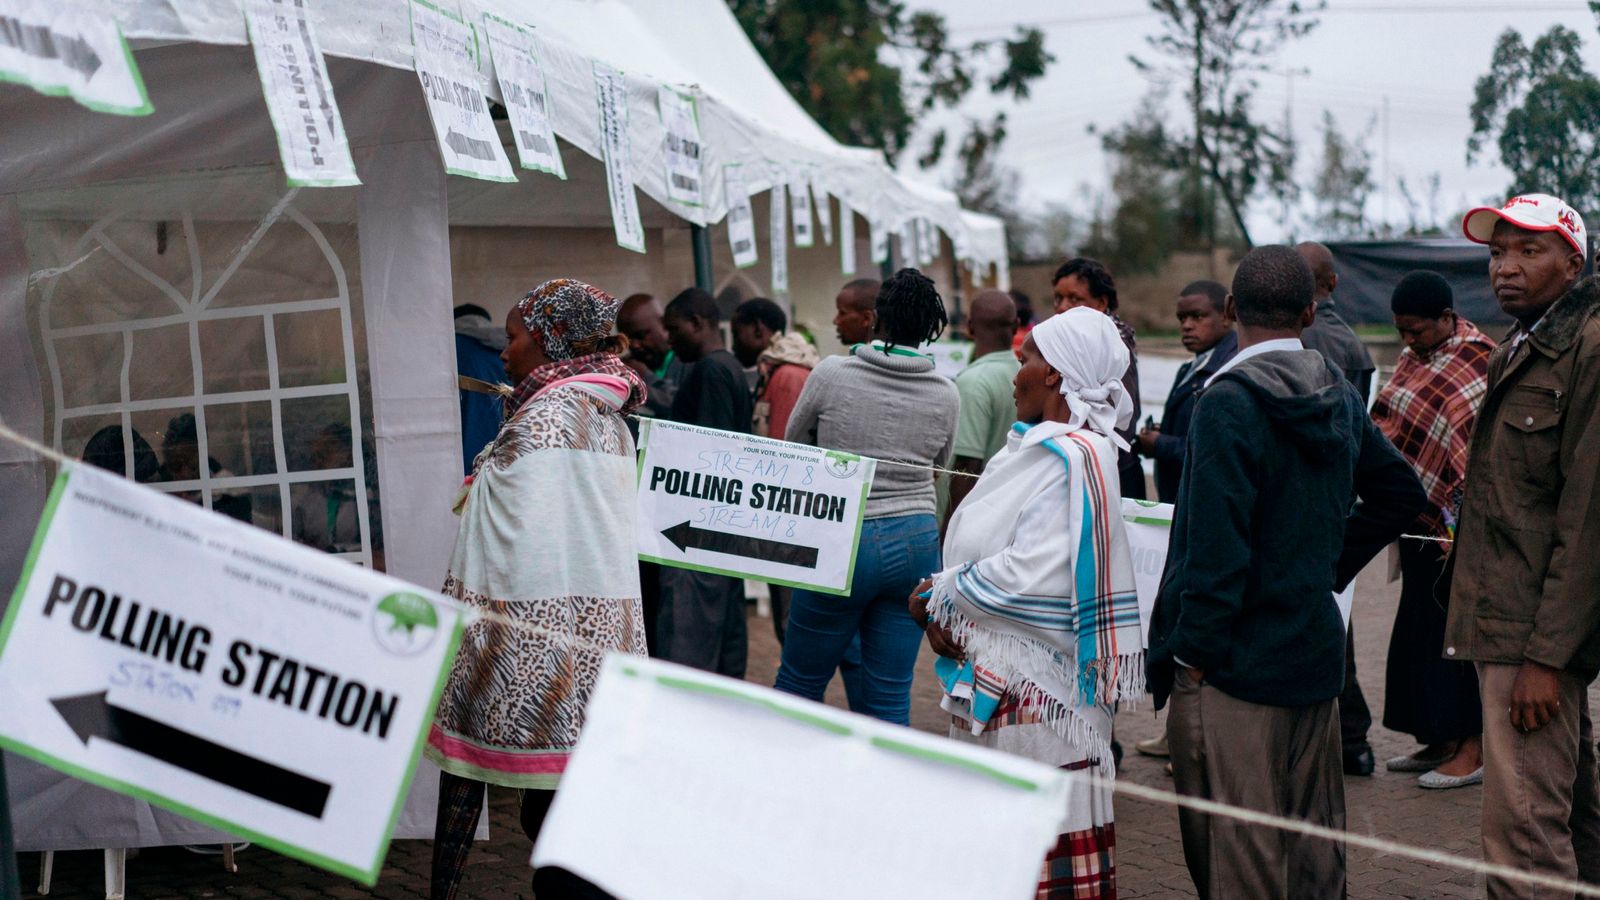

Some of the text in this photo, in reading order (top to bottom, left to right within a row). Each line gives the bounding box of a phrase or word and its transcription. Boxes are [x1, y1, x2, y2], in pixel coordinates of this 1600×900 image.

[282, 43, 325, 166] POLLING
[657, 421, 695, 433] DEPENDENT
[695, 428, 730, 439] ELECTORAL
[784, 442, 823, 454] COMMISSION
[743, 446, 820, 464] YOUR VOTE, YOUR FUTURE
[690, 450, 816, 486] STREAM 8
[649, 465, 847, 523] POLLING STATION
[692, 504, 798, 538] STREAM 8
[41, 572, 402, 742] POLLING STATION
